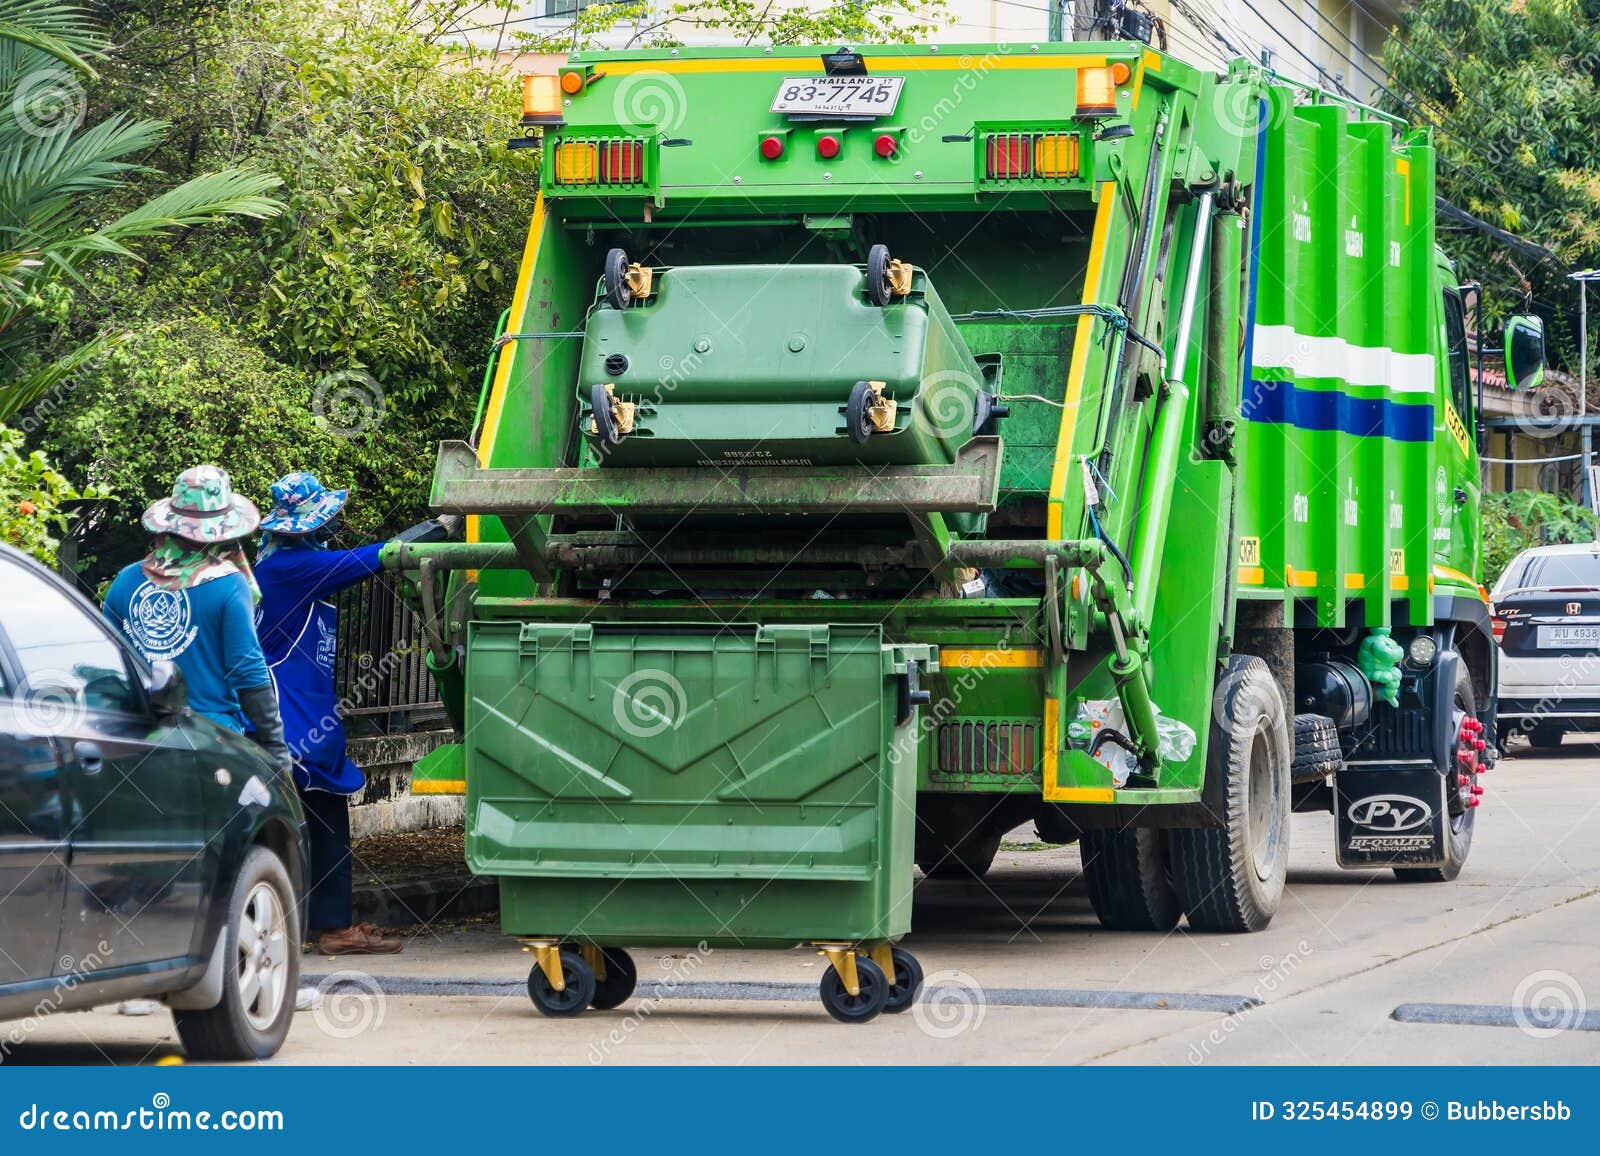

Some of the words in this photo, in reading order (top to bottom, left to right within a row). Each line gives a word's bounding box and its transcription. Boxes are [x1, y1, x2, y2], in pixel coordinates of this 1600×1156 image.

[783, 85, 892, 103] 83-7745
[1498, 608, 1521, 616] CITY
[1349, 838, 1432, 848] HI-QUALITY
